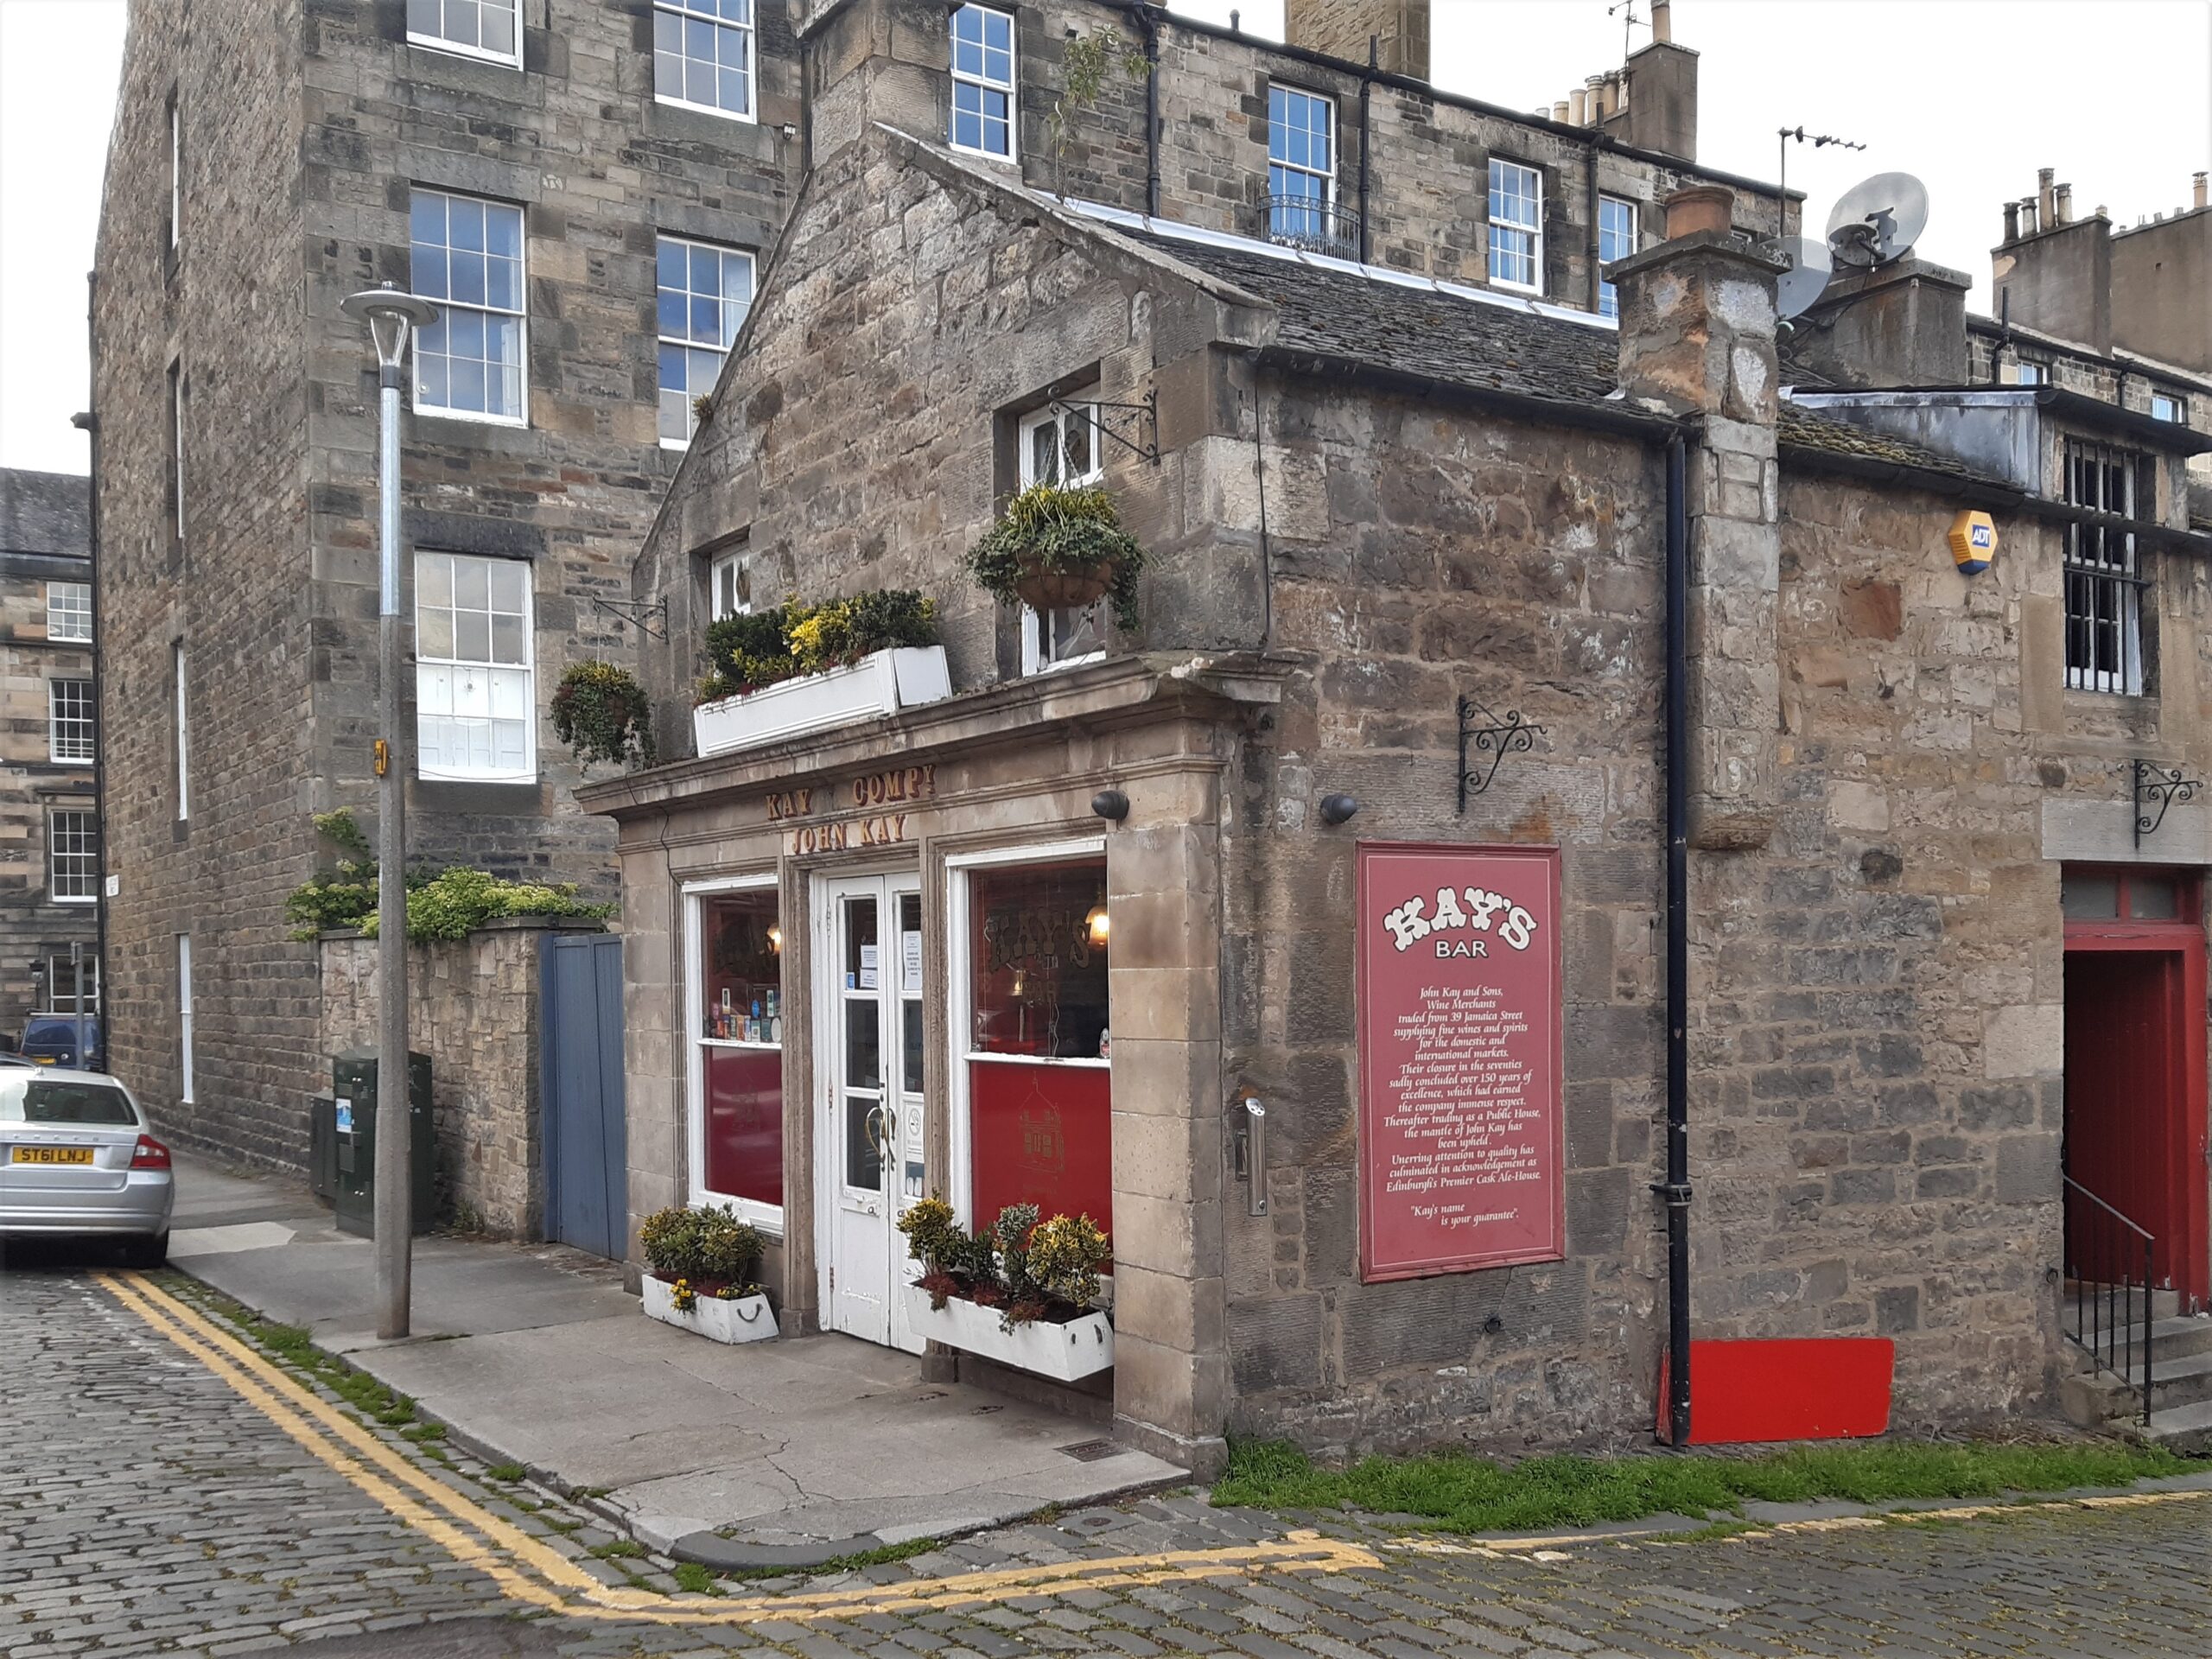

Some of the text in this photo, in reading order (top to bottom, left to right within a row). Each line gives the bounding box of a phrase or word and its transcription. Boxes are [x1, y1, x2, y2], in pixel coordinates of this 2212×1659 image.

[1973, 528, 1990, 544] ADT
[766, 787, 814, 821] KAY
[791, 814, 906, 855] JOHN KAY
[1383, 887, 1538, 951] KAY'S
[1435, 940, 1489, 958] BAR
[1420, 986, 1439, 999] John
[1442, 988, 1460, 1000] Kay
[1463, 985, 1481, 996] and
[1427, 998, 1496, 1009] Wine Merchants
[1398, 1011, 1522, 1027] traded from 39 Jamaica Street
[1394, 1025, 1436, 1040] supplying
[1438, 1024, 1453, 1037] fine
[1484, 1021, 1502, 1033] and
[1503, 1023, 1529, 1036] spirits
[1419, 1035, 1506, 1052] for the domestic and
[1415, 1047, 1471, 1061] international
[1399, 1059, 1522, 1074] Their closure in the seventies
[1389, 1076, 1413, 1090] sadly
[1415, 1073, 1459, 1086] concluded
[1481, 1073, 1496, 1083] 150
[1499, 1073, 1520, 1085] years
[1522, 1070, 1533, 1083] of
[1401, 1082, 1522, 1100] excellence, which had earned
[1398, 1101, 1412, 1113] the
[1415, 1102, 1455, 1115] company
[1459, 1099, 1494, 1109] immense
[1384, 1115, 1429, 1131] Thereafter
[1433, 1109, 1463, 1126] trading
[1486, 1109, 1511, 1120] Public
[1405, 1121, 1522, 1139] the mantle of John Kay has
[1438, 1137, 1457, 1148] been
[22, 1148, 86, 1162] ST61 LNJ
[1392, 1143, 1535, 1166] Unerring attention to quality has
[1389, 1163, 1439, 1178] culminated
[1441, 1164, 1450, 1173] in
[1452, 1157, 1526, 1173] acknowledgement
[1441, 1177, 1474, 1187] Premier
[1477, 1173, 1496, 1185] Cask
[1441, 1204, 1465, 1214] name
[1441, 1215, 1448, 1225] is
[1451, 1216, 1471, 1229] your
